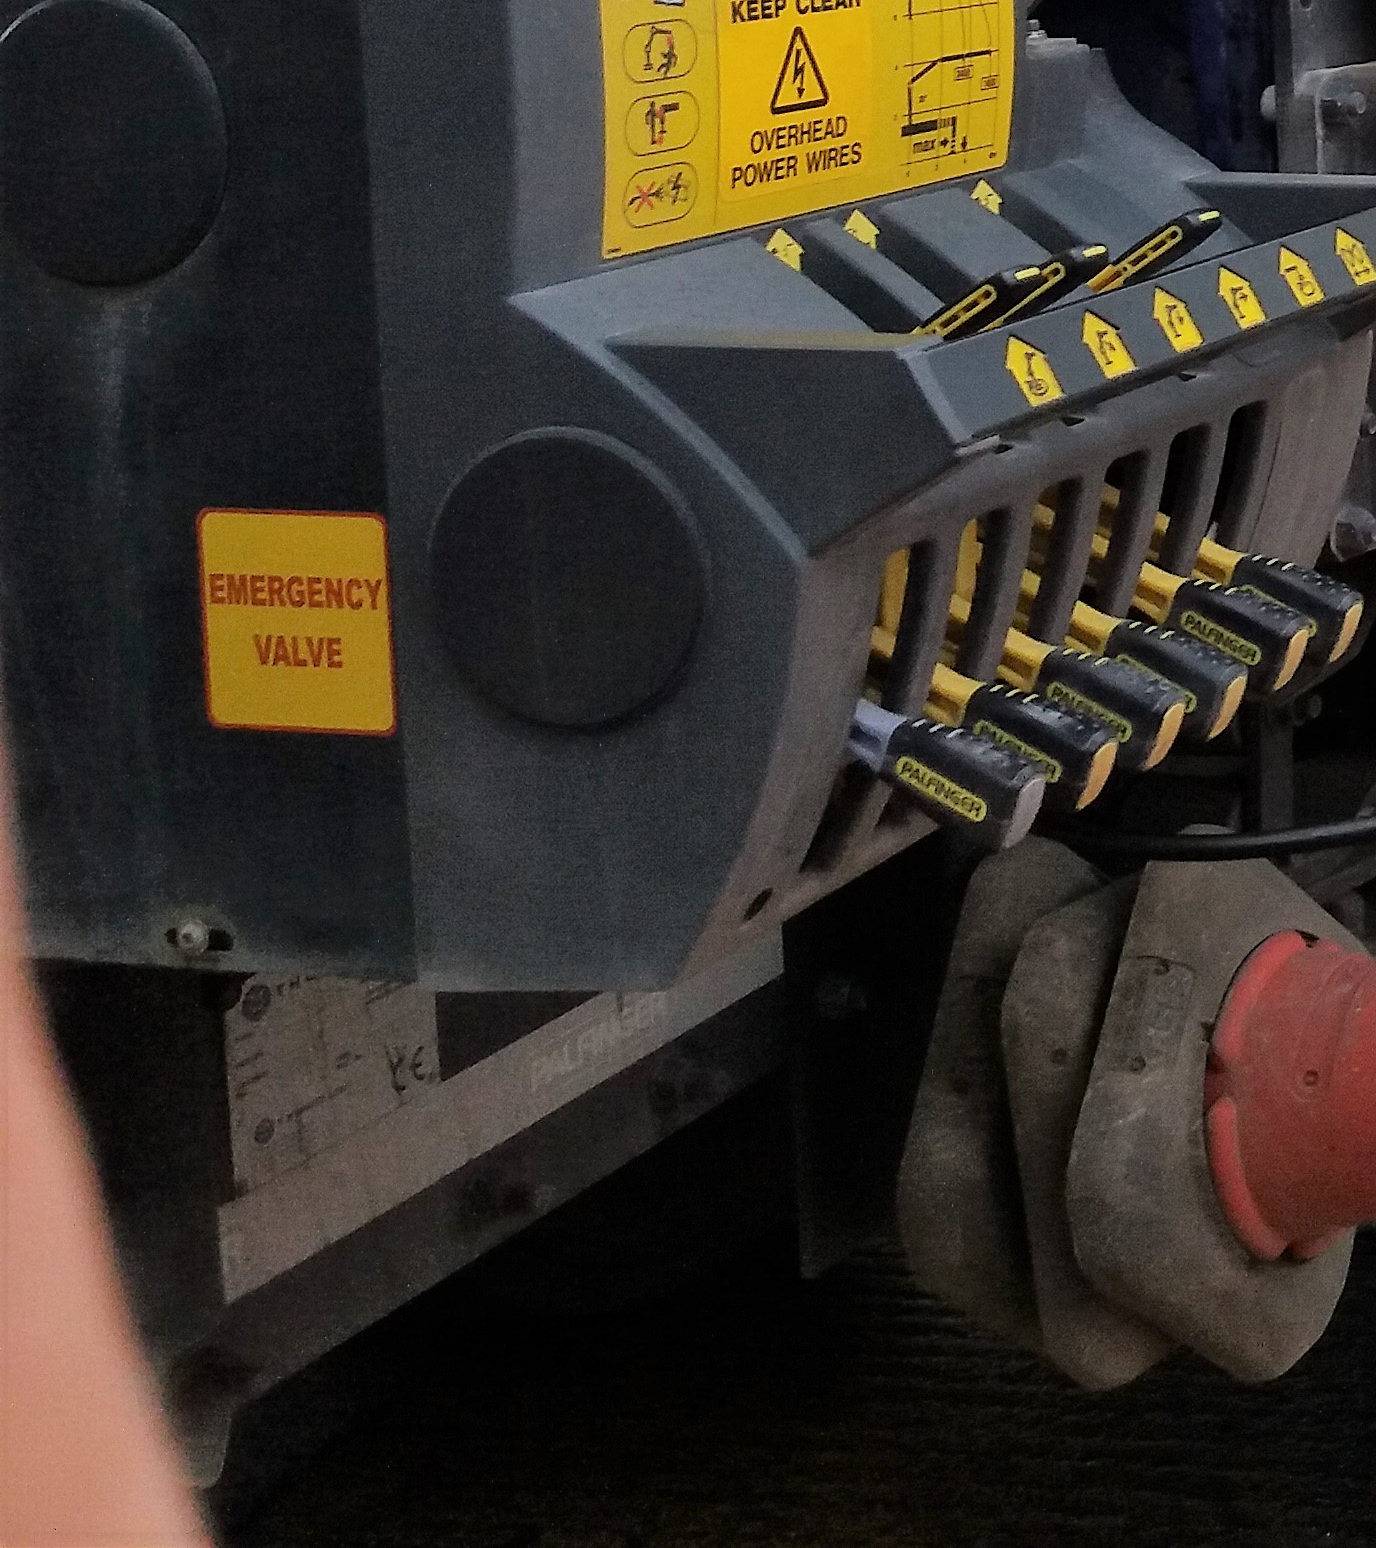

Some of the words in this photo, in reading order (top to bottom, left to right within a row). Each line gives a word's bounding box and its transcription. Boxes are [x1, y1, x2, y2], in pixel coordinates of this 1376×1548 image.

[750, 116, 848, 155] OVERHEAD
[731, 159, 798, 190] POWER
[806, 142, 862, 174] WIRES
[208, 573, 383, 611] EMERGENCY
[253, 633, 344, 669] VALVE
[1186, 615, 1257, 662] PALFINGER
[902, 761, 982, 815] PALFINGER
